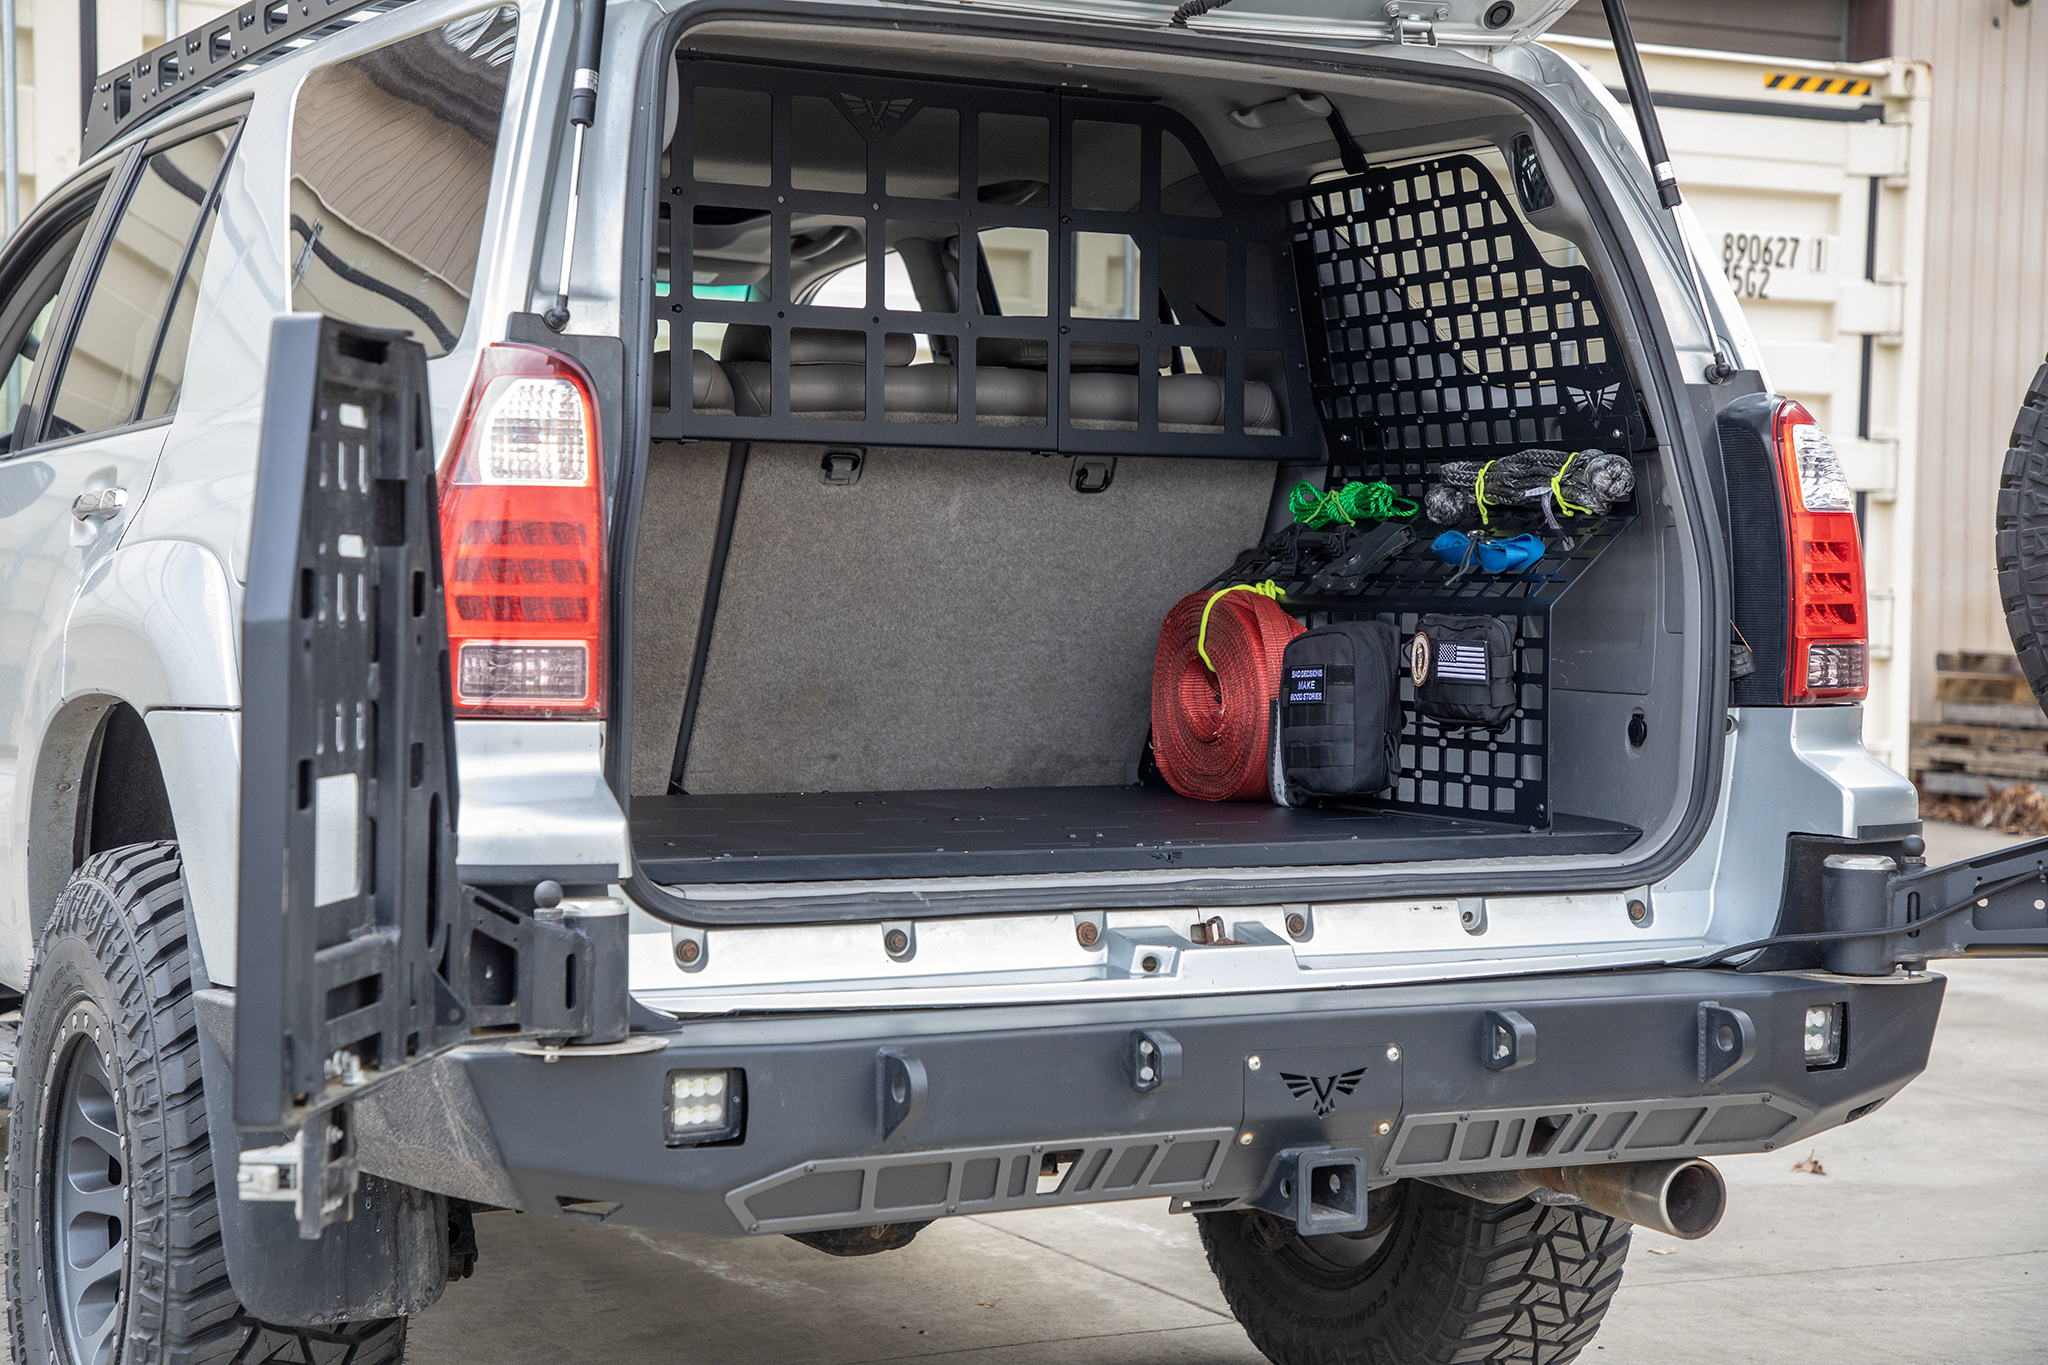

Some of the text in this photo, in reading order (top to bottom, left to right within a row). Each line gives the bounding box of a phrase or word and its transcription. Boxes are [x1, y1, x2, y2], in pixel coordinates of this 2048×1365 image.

[1723, 232, 1800, 269] 890627
[1291, 669, 1323, 679] BAD DECISIONS
[1297, 680, 1316, 690] MAKE
[1290, 692, 1323, 701] GOOD STORIES
